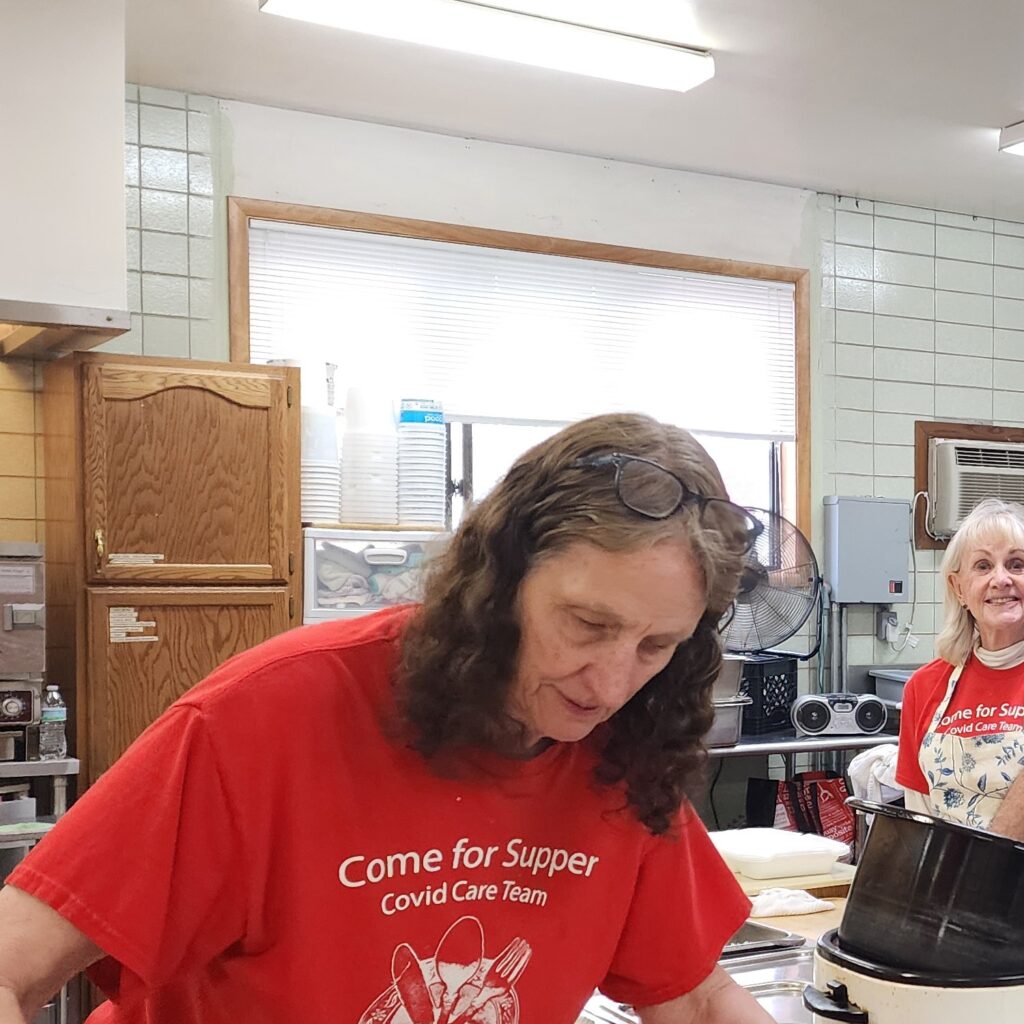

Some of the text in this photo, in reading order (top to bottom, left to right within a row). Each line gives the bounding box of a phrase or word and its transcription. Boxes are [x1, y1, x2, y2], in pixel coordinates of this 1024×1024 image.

[938, 708, 972, 727] ome
[976, 703, 997, 718] for
[975, 721, 997, 732] Care
[999, 721, 1023, 731] Team
[338, 838, 599, 888] Come for Supper
[381, 880, 548, 916] Covid Care Team
